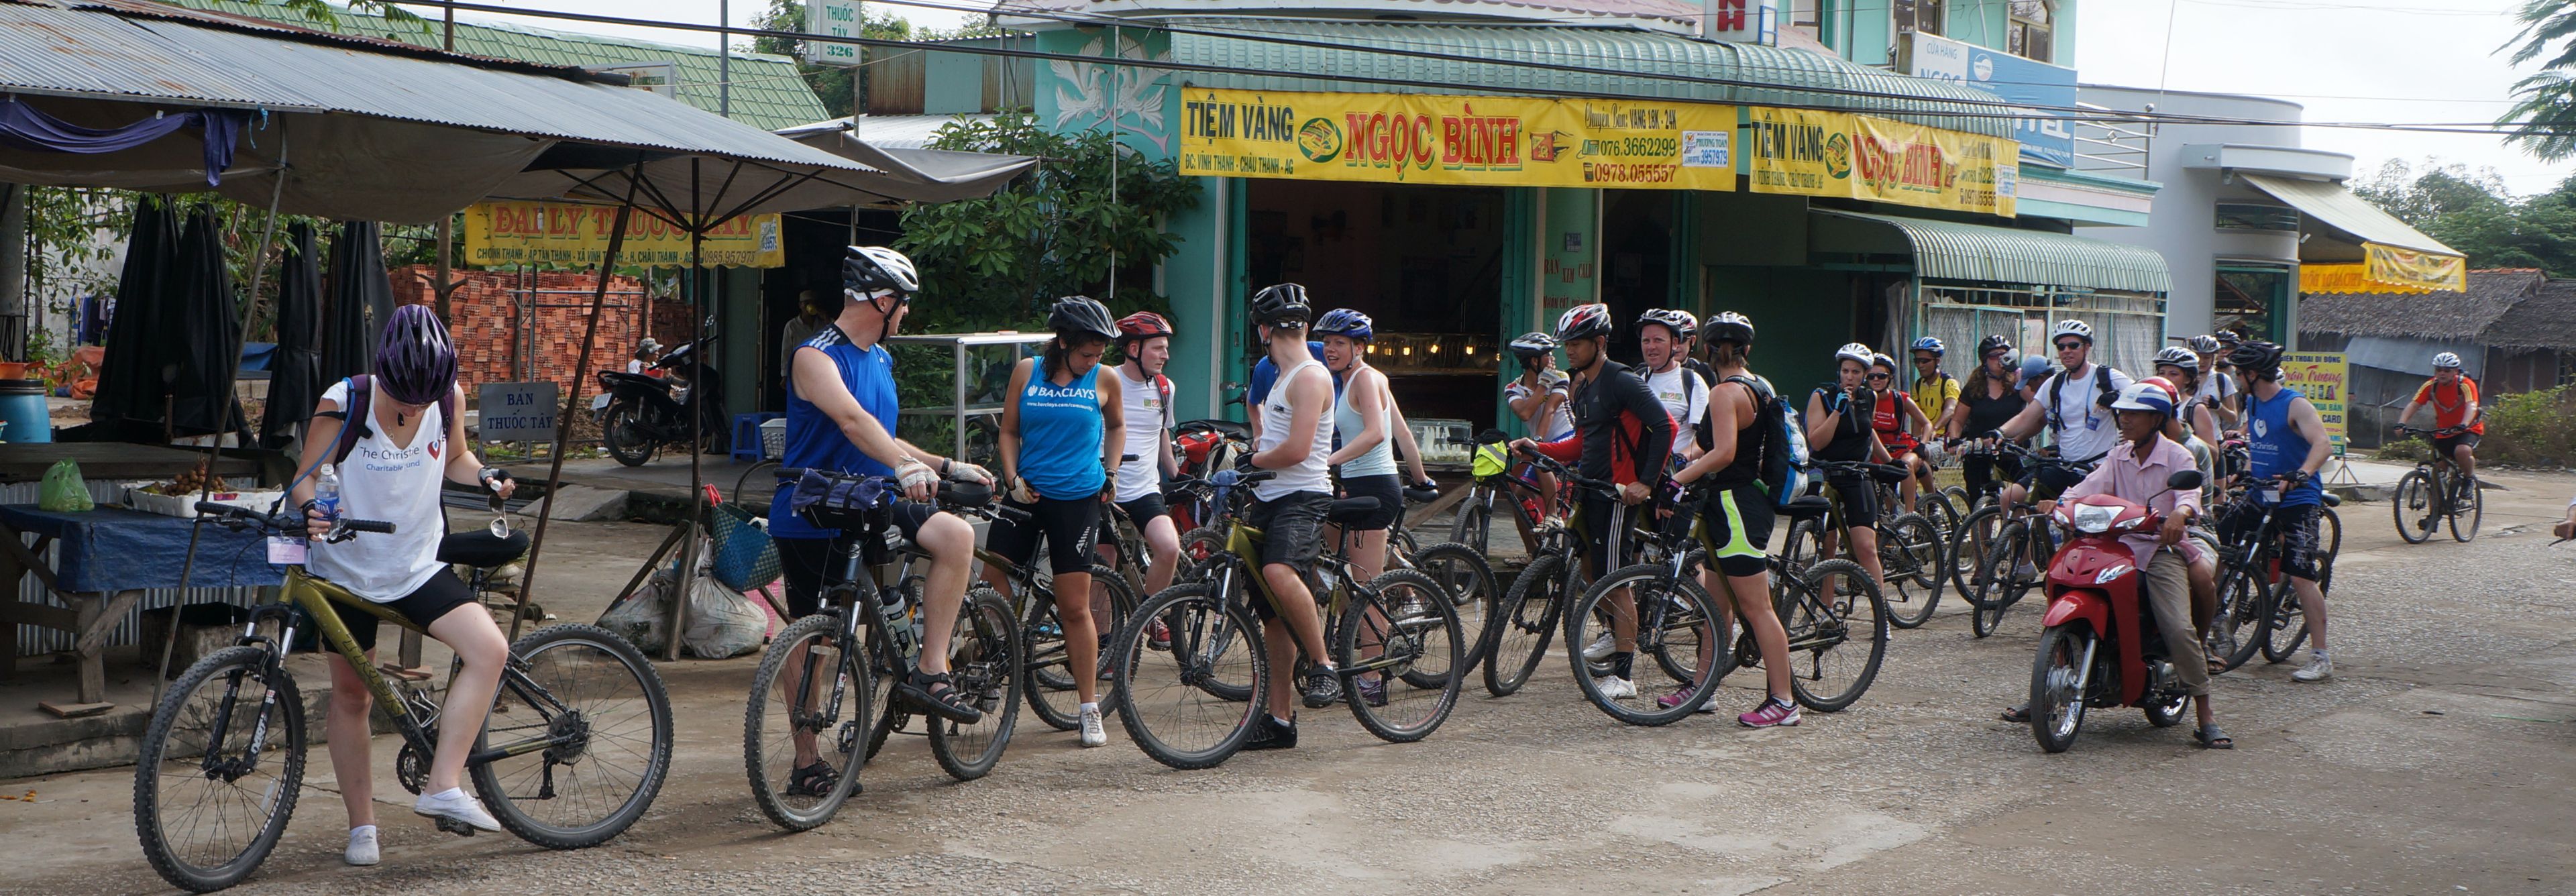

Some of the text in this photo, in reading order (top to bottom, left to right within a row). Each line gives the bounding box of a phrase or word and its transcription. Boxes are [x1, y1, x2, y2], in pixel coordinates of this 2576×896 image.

[826, 3, 853, 22] THUỐC
[826, 45, 853, 58] 326
[1187, 92, 1294, 145] TIỆM VÀNG
[1629, 103, 1646, 129] VÀNG
[1648, 109, 1660, 129] 18K
[1665, 109, 1676, 129] 24K
[1344, 101, 1521, 180] NGỌC BÌNH
[1601, 137, 1676, 157] 076.3662299
[1790, 115, 1823, 163] VÀNG
[1198, 150, 1212, 170] VĨNH
[1214, 151, 1234, 172] THÀNH
[1240, 152, 1257, 172] CHÂU
[1258, 154, 1279, 174] THÀNH
[1284, 158, 1294, 174] AG
[1701, 149, 1727, 165] 3957979
[1595, 164, 1676, 182] 0978.055557
[551, 247, 571, 261] THÀNH
[638, 248, 655, 262] CHÂU
[657, 247, 678, 262] THÀNH
[507, 388, 533, 405] BÁN
[488, 409, 553, 429] THUỐC TÂY
[2322, 414, 2341, 423] CARD
[381, 446, 420, 460] Christie
[366, 460, 421, 471] Charitable und
[343, 632, 407, 716] TREK
[644, 742, 666, 797] BONTRAGER
[283, 754, 303, 817] BONTRAGER
